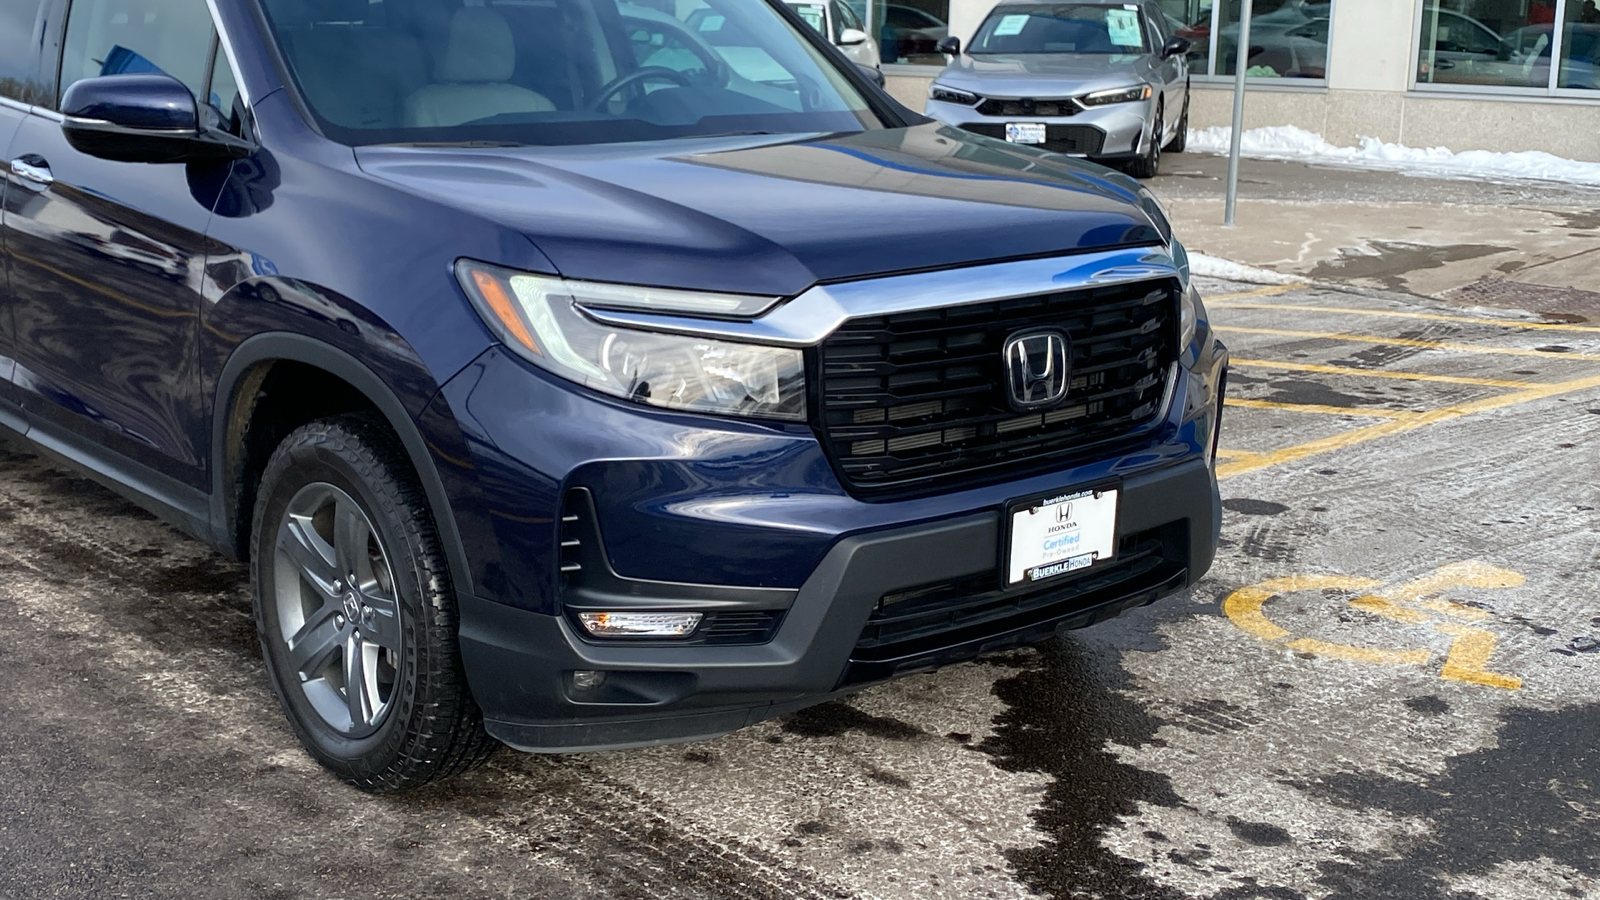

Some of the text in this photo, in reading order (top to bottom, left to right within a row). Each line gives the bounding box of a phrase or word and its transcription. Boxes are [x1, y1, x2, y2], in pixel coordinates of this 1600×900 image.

[1043, 490, 1092, 505] buerklehonda.com
[1048, 522, 1077, 533] HONDA
[1043, 532, 1080, 550] Certified
[1042, 544, 1080, 559] Pre-Owned
